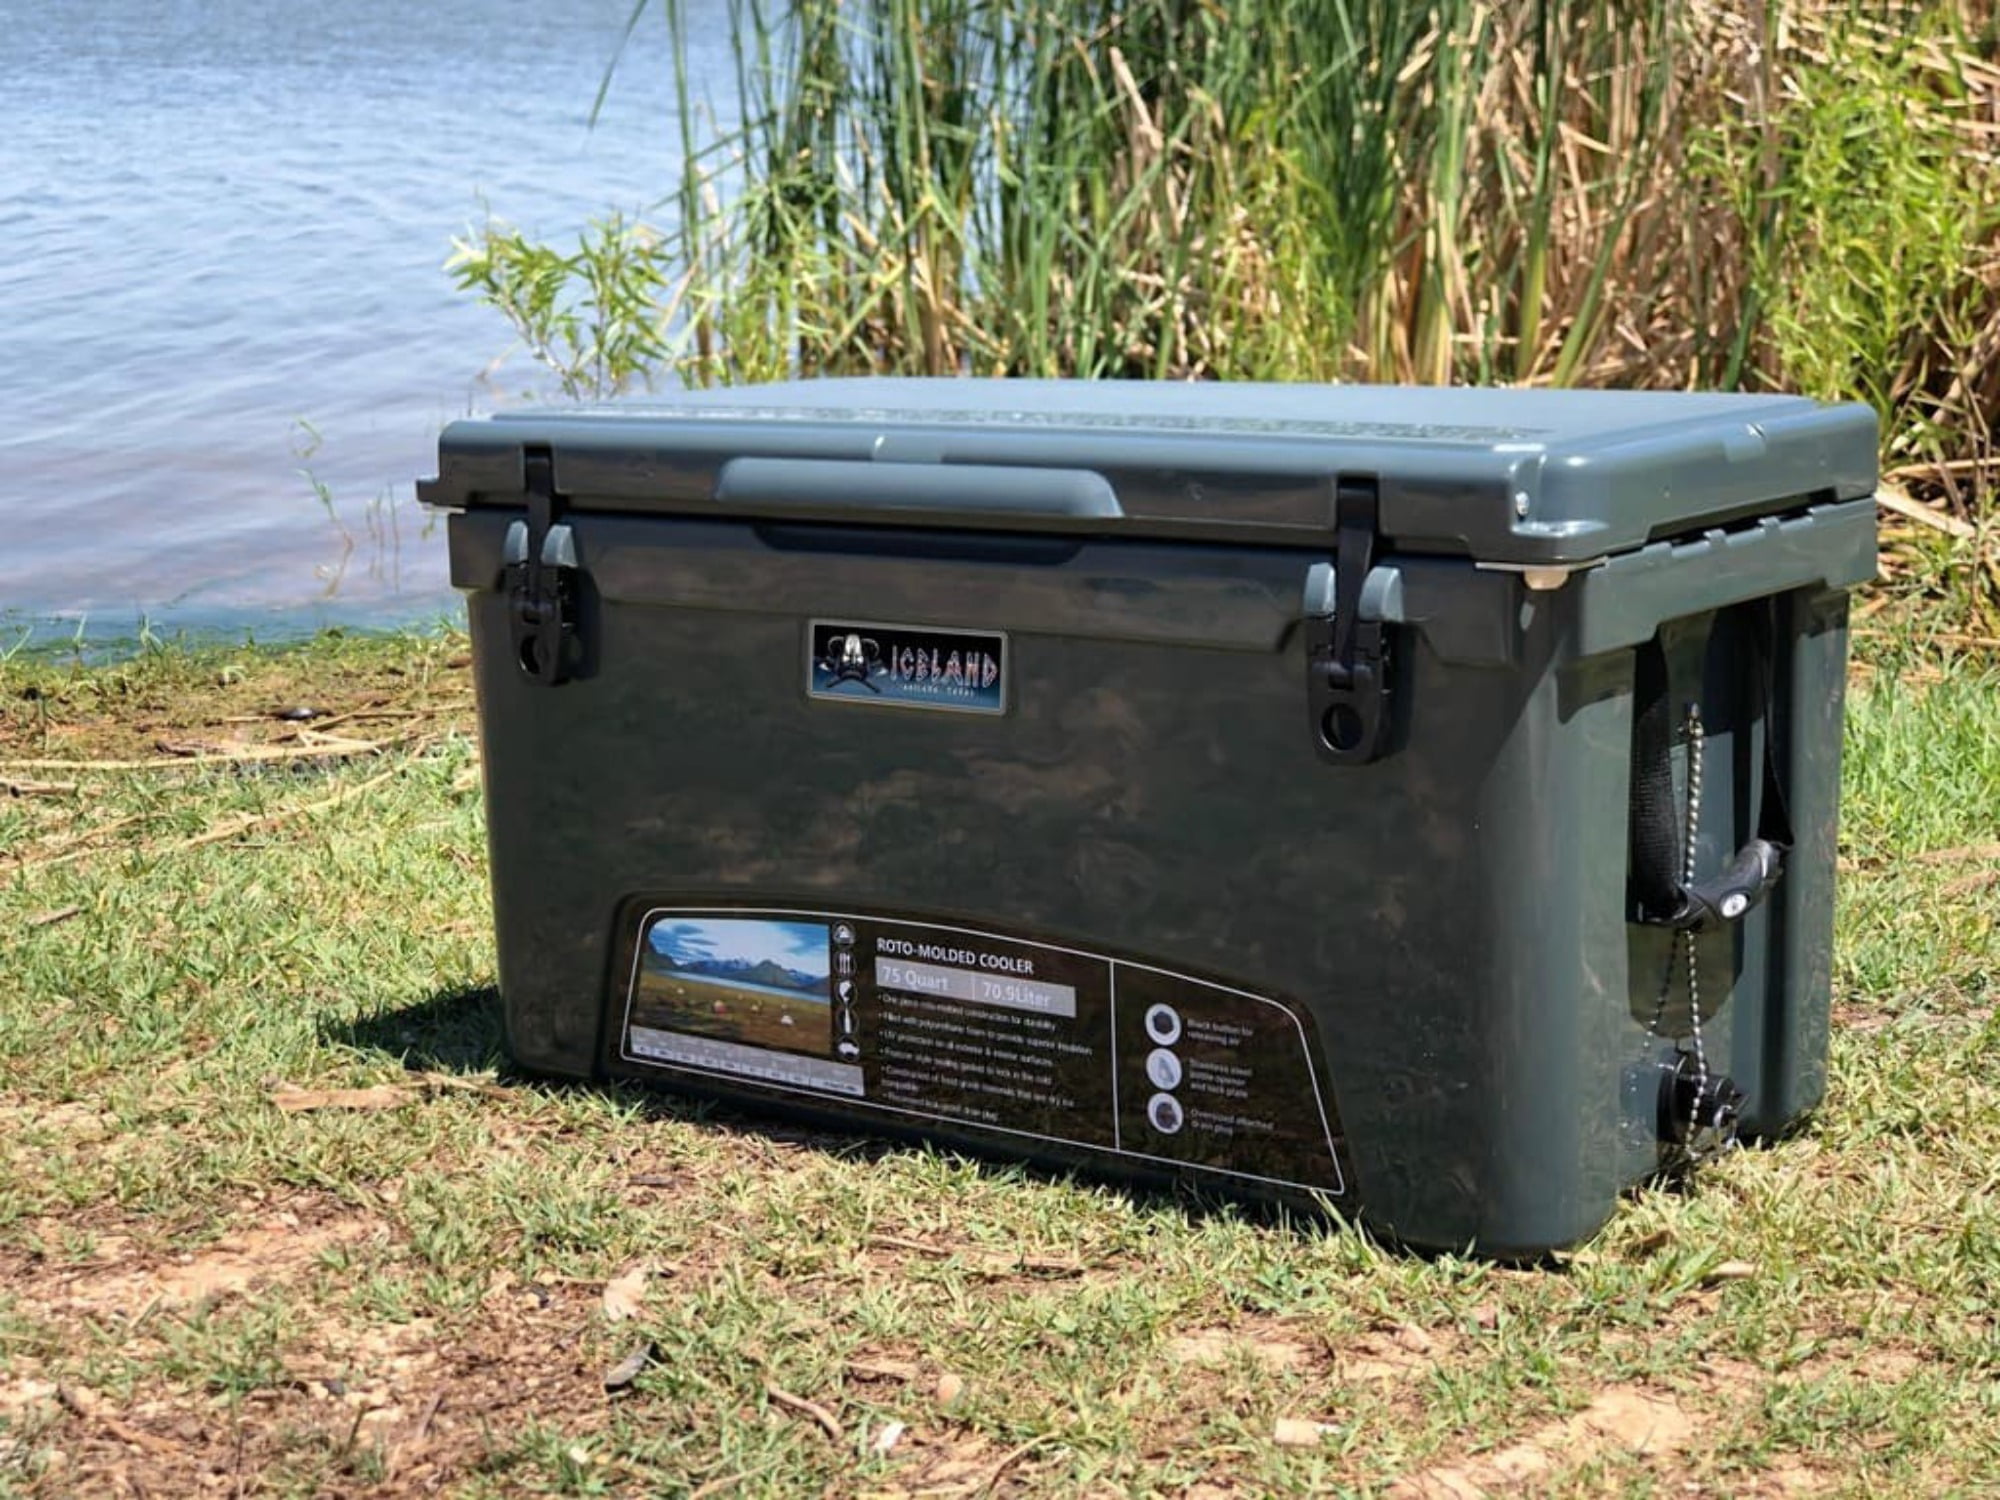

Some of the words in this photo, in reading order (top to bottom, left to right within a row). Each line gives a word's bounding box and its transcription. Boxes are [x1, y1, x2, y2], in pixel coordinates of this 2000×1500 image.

[890, 645, 998, 688] ICELAND
[876, 937, 976, 966] ROTO-MOLDED
[979, 955, 1034, 975] COOLER
[881, 965, 900, 984] 75
[904, 969, 948, 991] Quart
